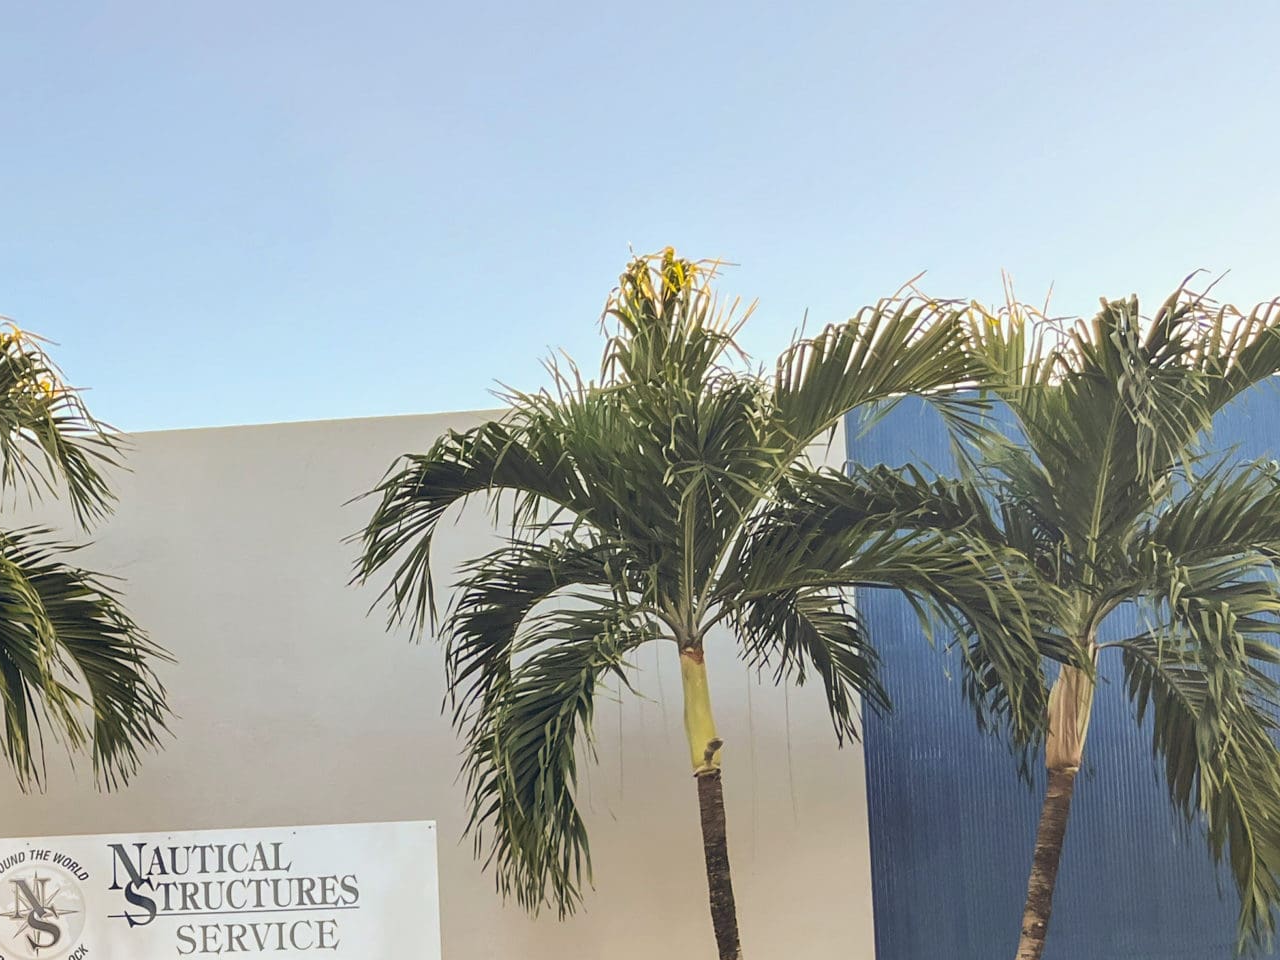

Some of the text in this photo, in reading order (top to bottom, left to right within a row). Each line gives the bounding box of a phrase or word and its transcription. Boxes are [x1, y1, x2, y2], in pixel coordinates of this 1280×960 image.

[29, 849, 52, 861] THE
[52, 852, 90, 882] WORLD
[107, 841, 293, 890] NAUTICAL
[124, 874, 360, 929] STRUCTURES
[176, 919, 341, 956] SERVICE
